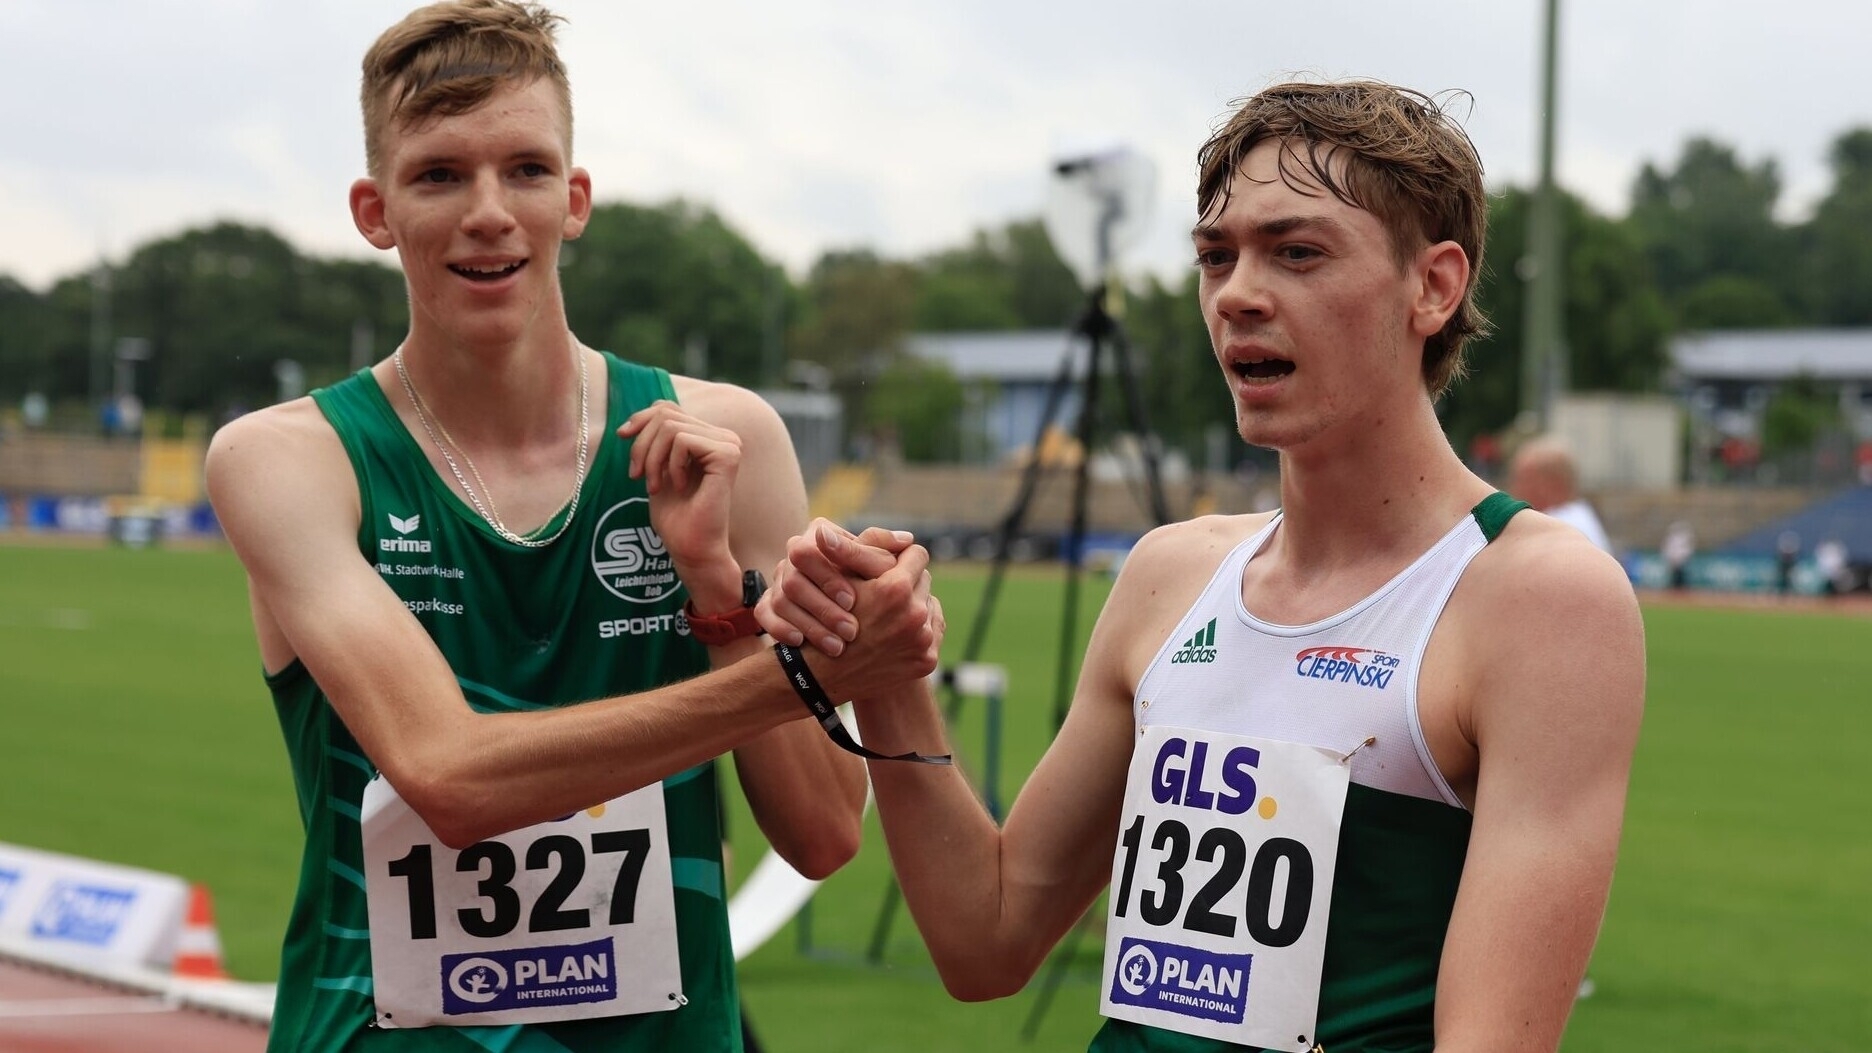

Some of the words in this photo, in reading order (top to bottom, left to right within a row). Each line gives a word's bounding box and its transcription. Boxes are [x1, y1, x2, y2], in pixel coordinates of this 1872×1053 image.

[380, 537, 432, 552] erima
[440, 567, 465, 579] Halle
[644, 557, 675, 571] Hal
[614, 572, 675, 588] Leichtathletik
[599, 614, 674, 639] SPORT
[1171, 645, 1217, 664] adidas
[1371, 654, 1400, 669] SPORT
[1297, 656, 1394, 690] CIERPINSKI
[388, 828, 651, 939] 1327
[1115, 815, 1314, 948] 1320
[515, 953, 608, 986] PLAN
[1161, 957, 1242, 998] PLAN
[516, 984, 609, 1000] INTERNATIONAL
[1158, 990, 1236, 1014] INTERNATIONAL
